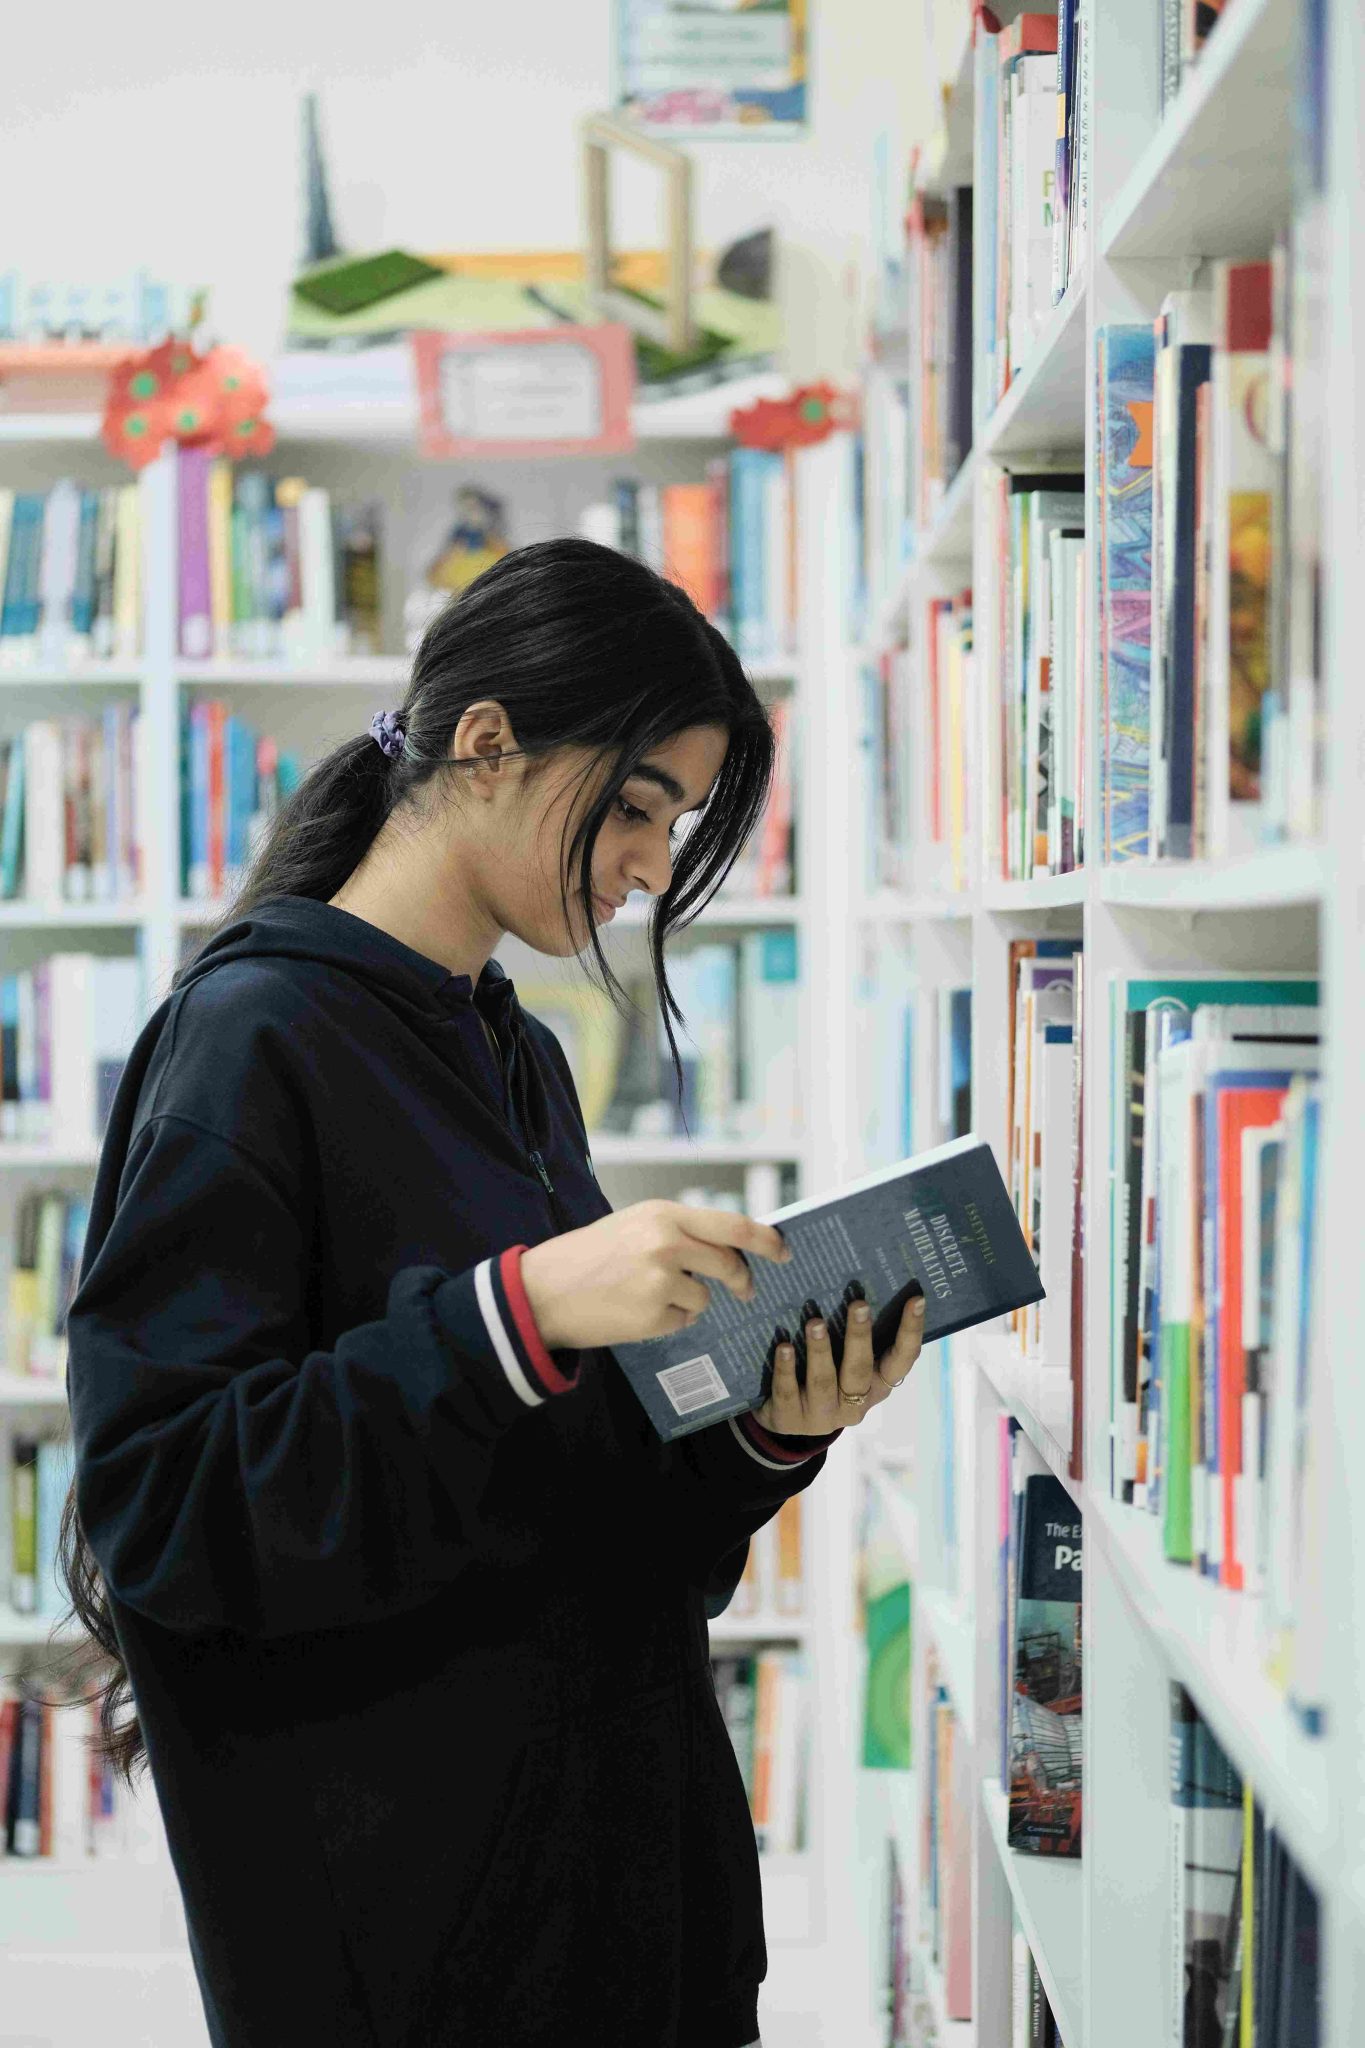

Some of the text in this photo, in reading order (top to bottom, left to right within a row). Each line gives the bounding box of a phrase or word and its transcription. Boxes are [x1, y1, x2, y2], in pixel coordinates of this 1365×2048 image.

[902, 1207, 952, 1299] MATHEMATICS
[930, 1213, 968, 1278] DISCRETE
[964, 1202, 996, 1264] ESSENTIALS
[1045, 1522, 1071, 1538] The
